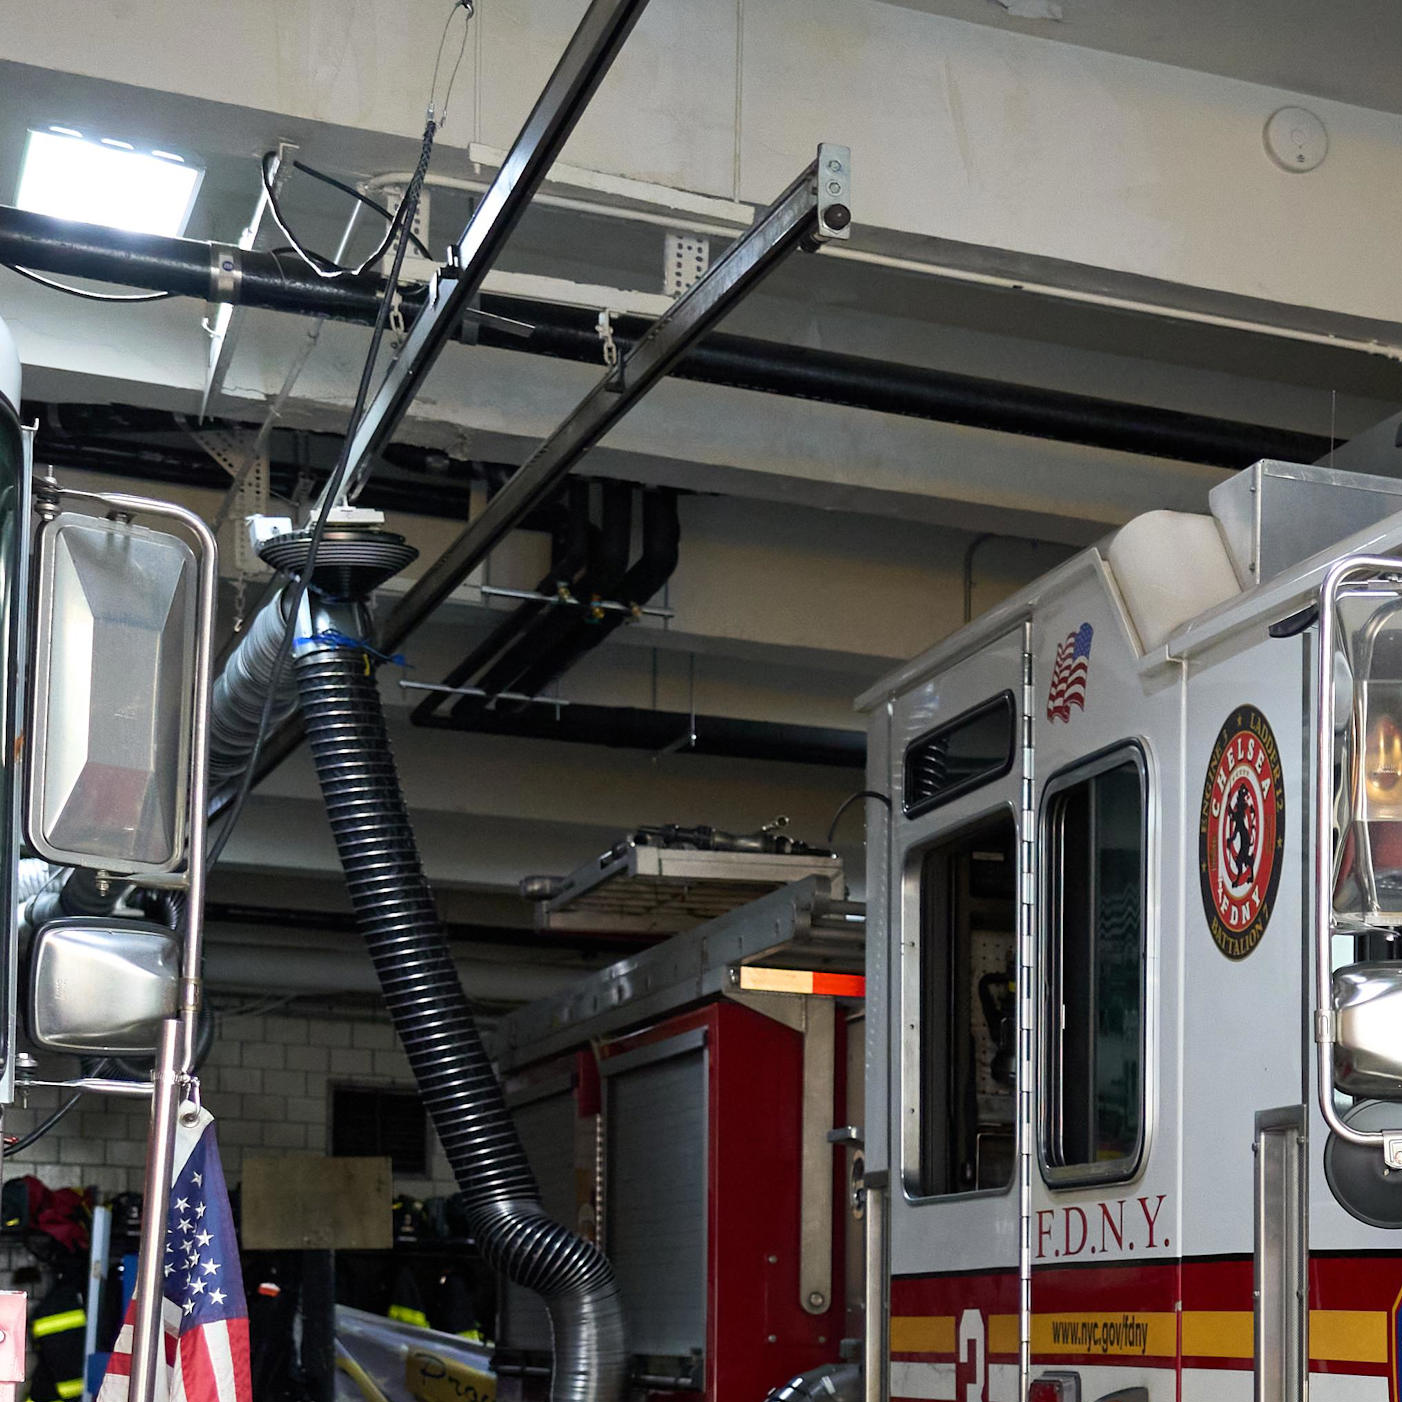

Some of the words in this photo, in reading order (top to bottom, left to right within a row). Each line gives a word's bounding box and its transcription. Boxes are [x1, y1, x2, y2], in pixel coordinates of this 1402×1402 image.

[1211, 738, 1271, 818] CHELSEA
[1249, 712, 1280, 780] LADDER
[1200, 746, 1222, 833] ENGINE
[1210, 916, 1263, 956] BATTALION
[1220, 885, 1261, 926] FDNY
[1035, 1194, 1170, 1258] F.D.N.Y.
[1052, 1315, 1148, 1354] www.nyc.gov/fdny
